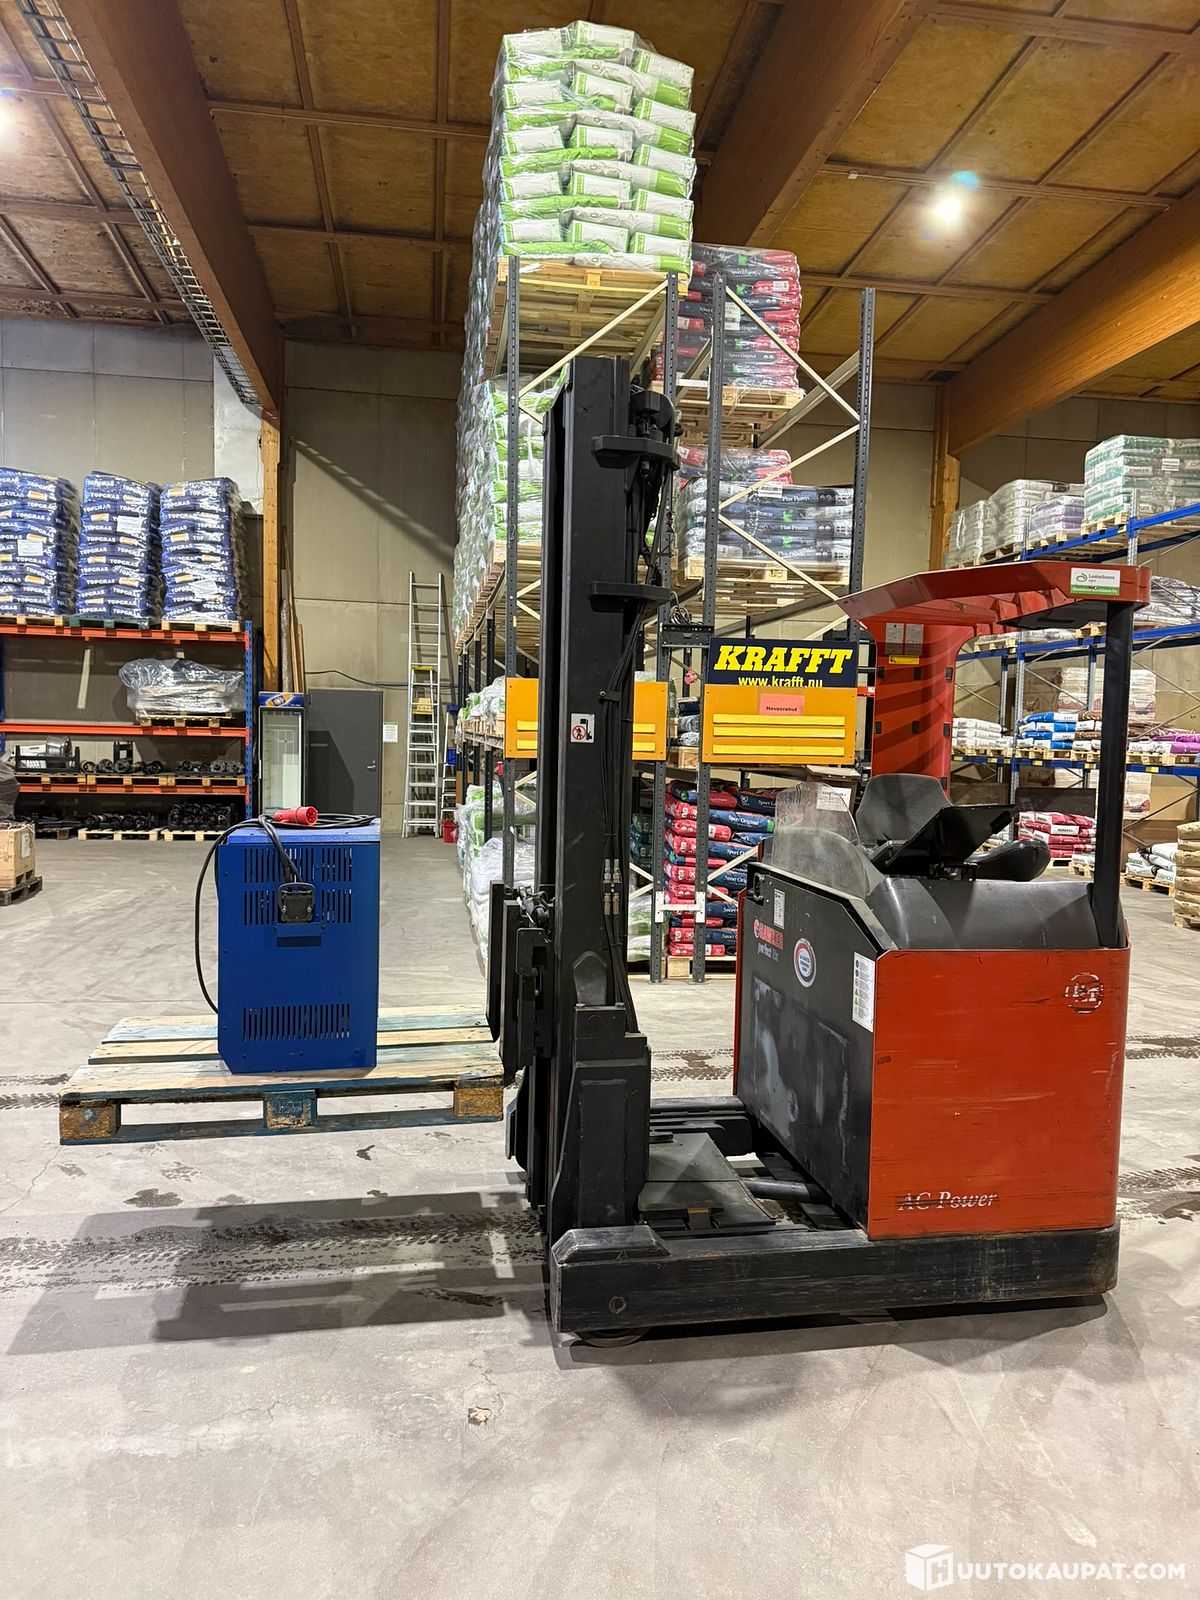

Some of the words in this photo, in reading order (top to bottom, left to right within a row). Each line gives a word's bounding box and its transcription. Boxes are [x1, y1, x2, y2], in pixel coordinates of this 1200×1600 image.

[713, 645, 853, 674] KRAFFT
[738, 676, 823, 688] www.krafft.nu
[898, 1192, 931, 1211] AC
[936, 1191, 998, 1209] Power
